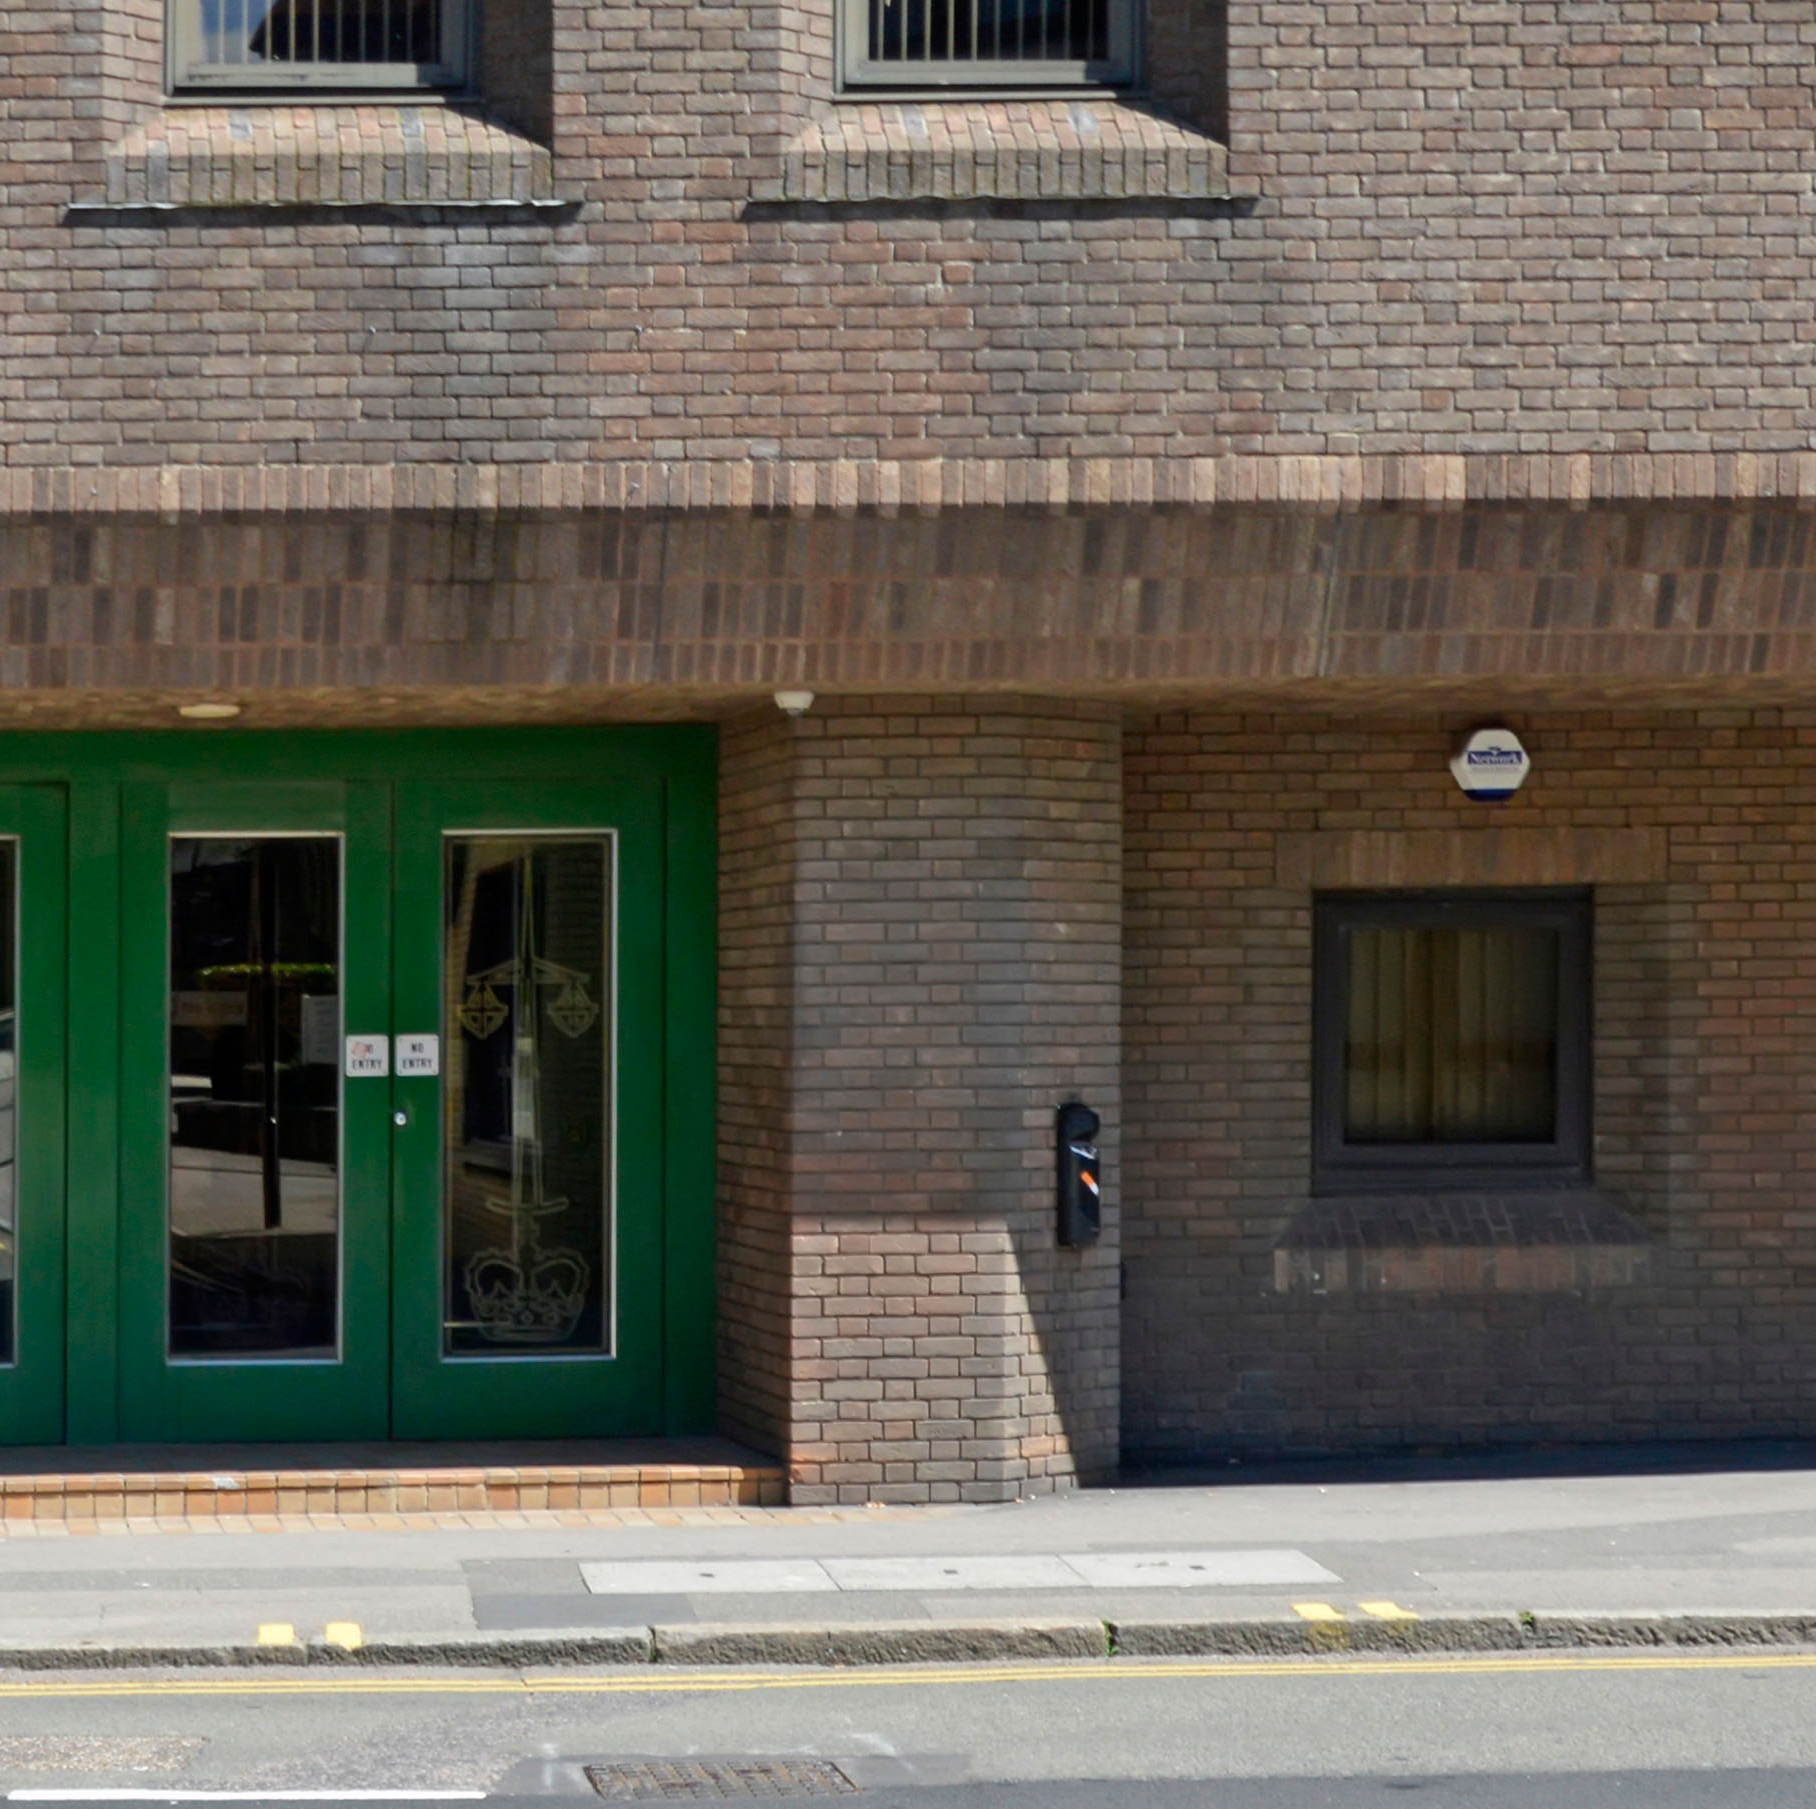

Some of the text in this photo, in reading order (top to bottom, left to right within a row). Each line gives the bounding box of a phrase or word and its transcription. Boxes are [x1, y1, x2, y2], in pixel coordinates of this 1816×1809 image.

[411, 1043, 424, 1054] NO
[352, 1059, 382, 1070] ENTRY
[402, 1059, 433, 1070] ENTRY
